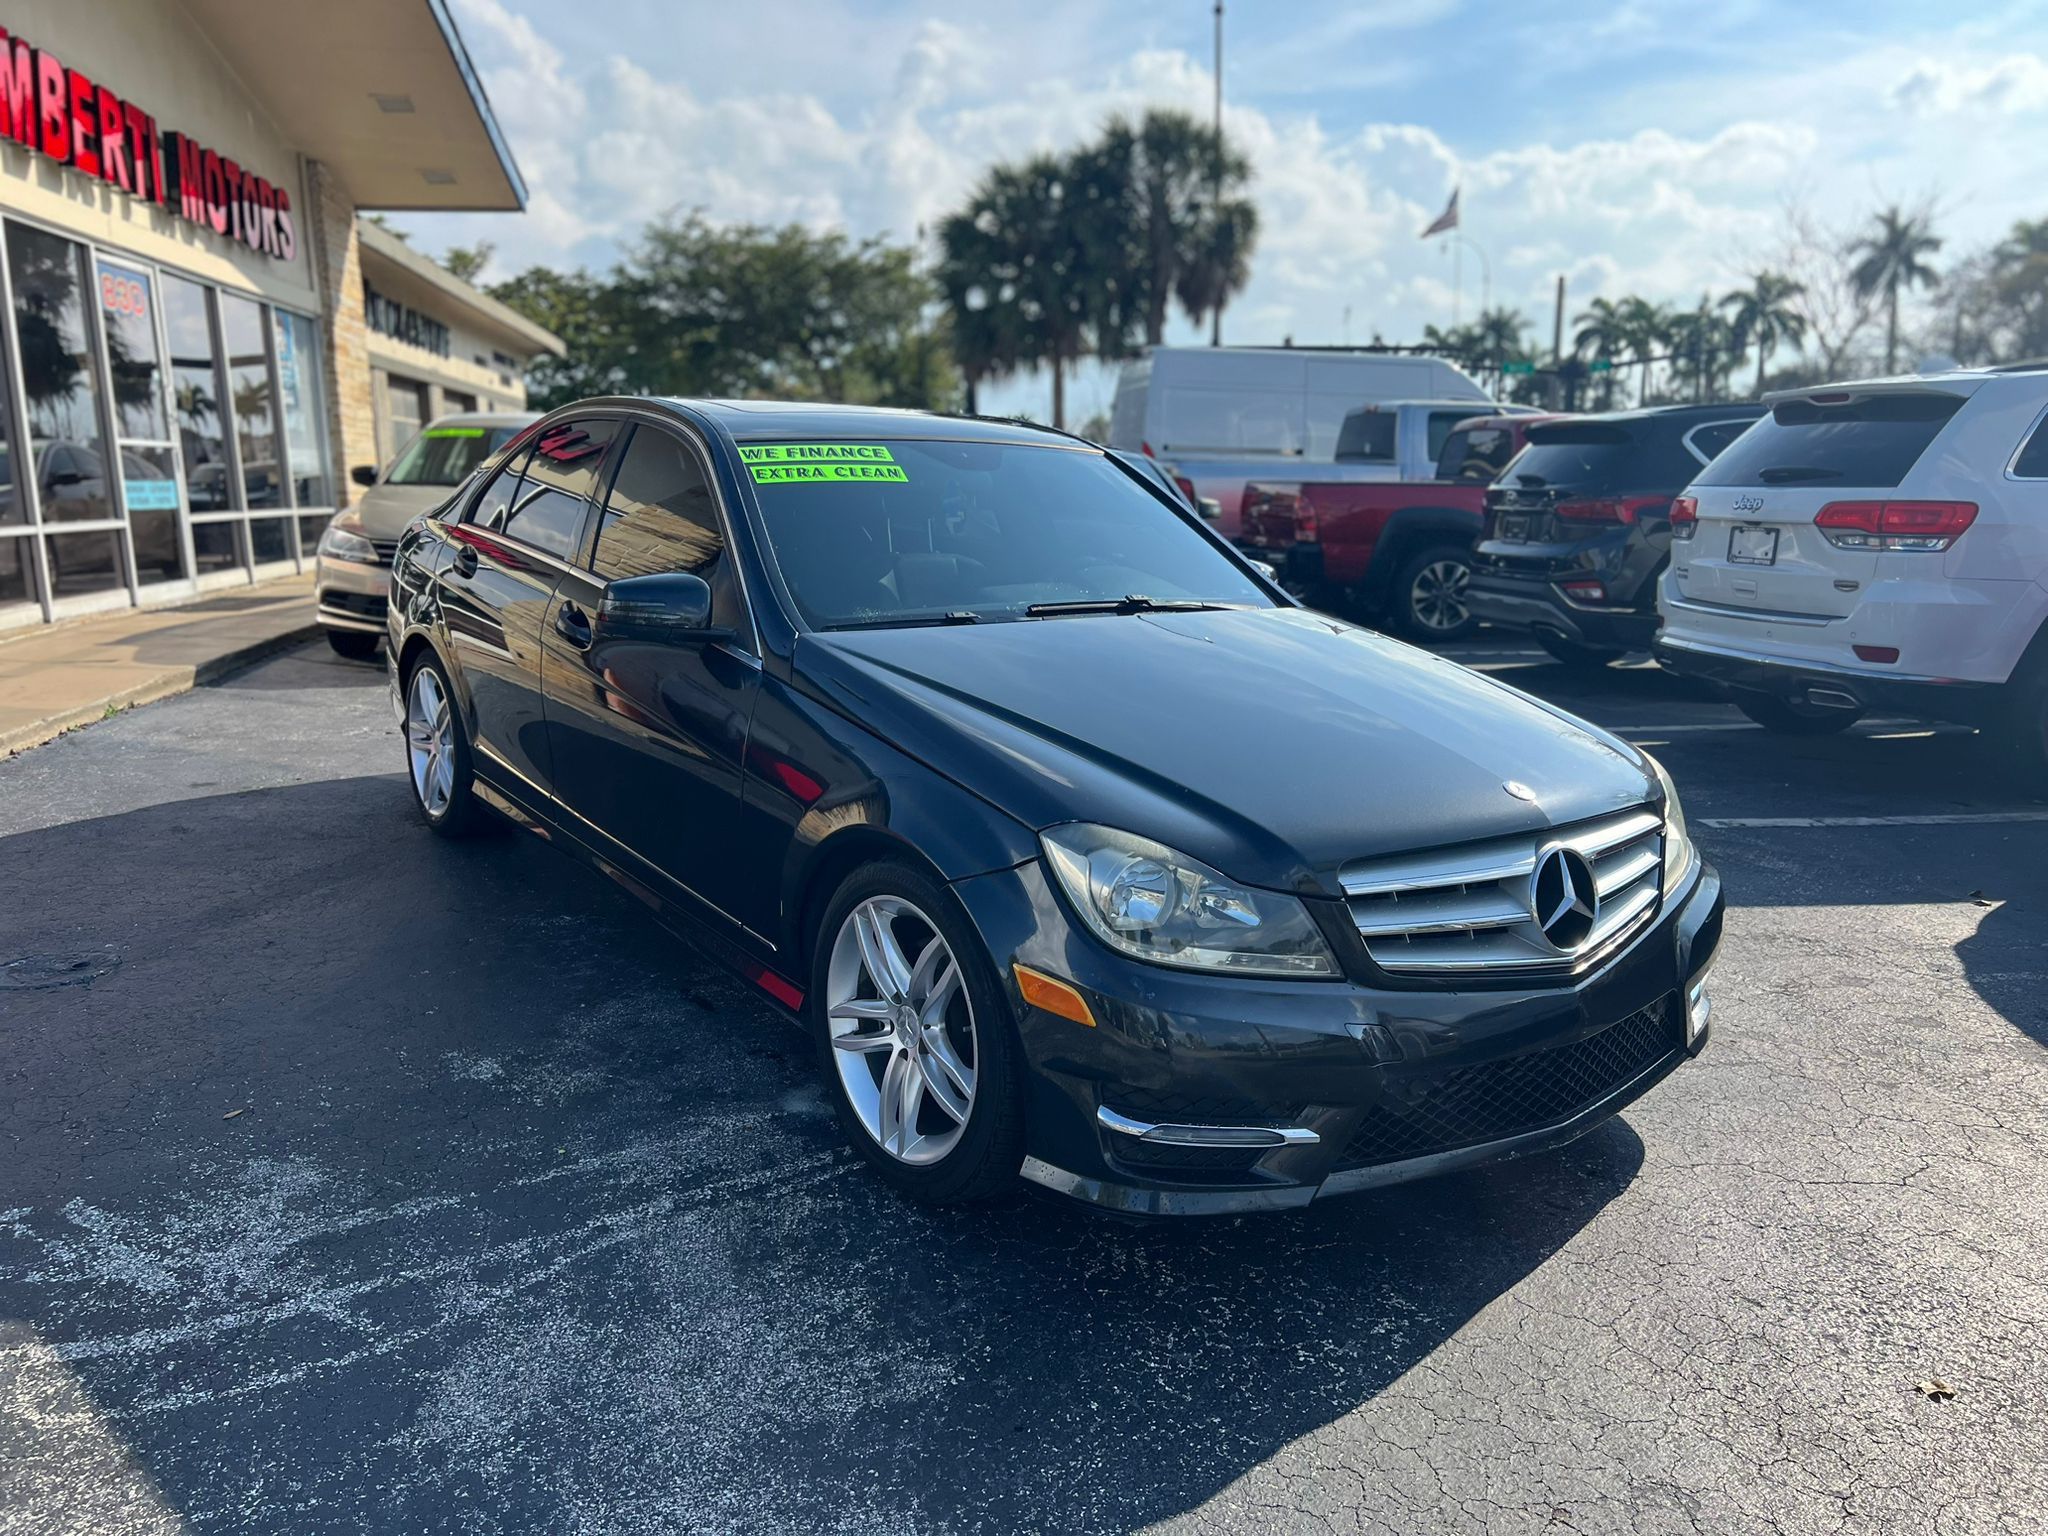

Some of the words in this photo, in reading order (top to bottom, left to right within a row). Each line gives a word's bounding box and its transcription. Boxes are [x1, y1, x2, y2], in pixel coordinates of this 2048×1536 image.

[176, 130, 296, 261] MOTORS
[741, 447, 778, 460] WE
[786, 447, 887, 459] FINANCE
[756, 467, 825, 479] EXTRA
[834, 466, 900, 479] CLEAN
[1732, 495, 1764, 513] Jeep
